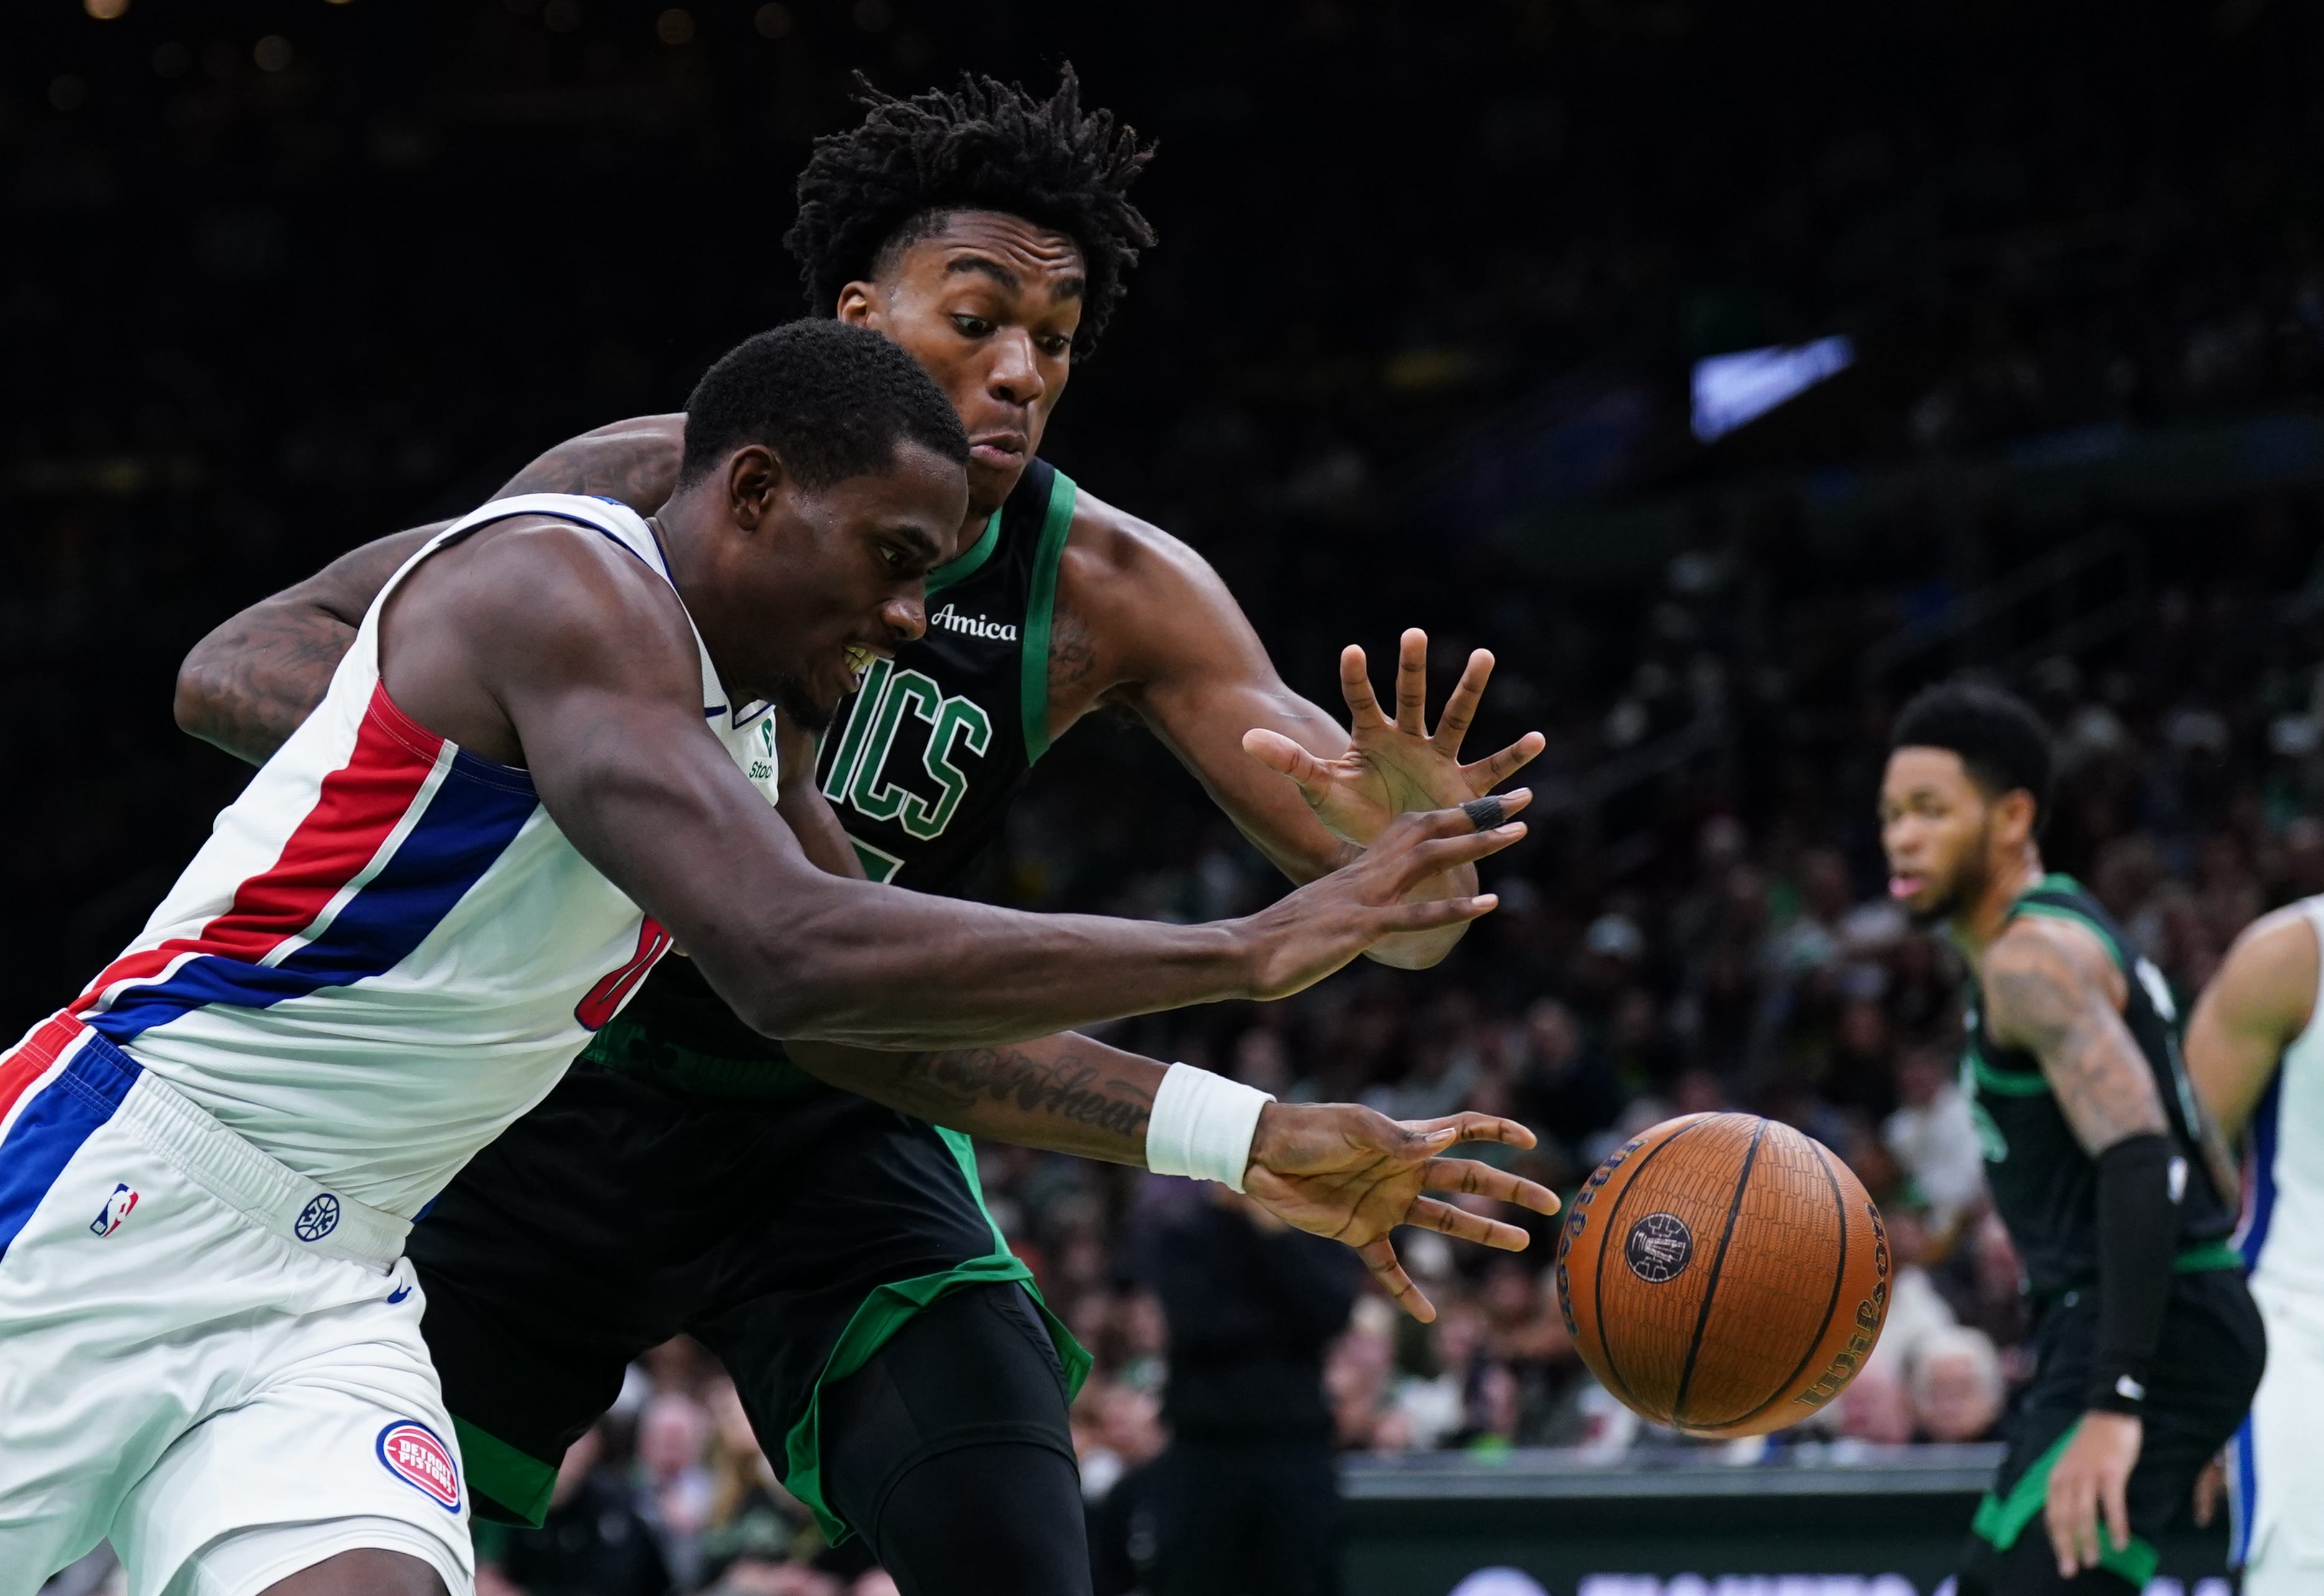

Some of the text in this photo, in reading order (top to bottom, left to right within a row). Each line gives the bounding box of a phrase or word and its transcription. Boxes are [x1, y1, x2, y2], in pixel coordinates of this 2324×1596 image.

[931, 603, 1016, 641] Amica
[748, 761, 773, 779] Stoc
[1793, 1202, 1889, 1406] Wilson
[398, 1439, 452, 1483] DETROIT
[398, 1450, 452, 1494] PISTONS
